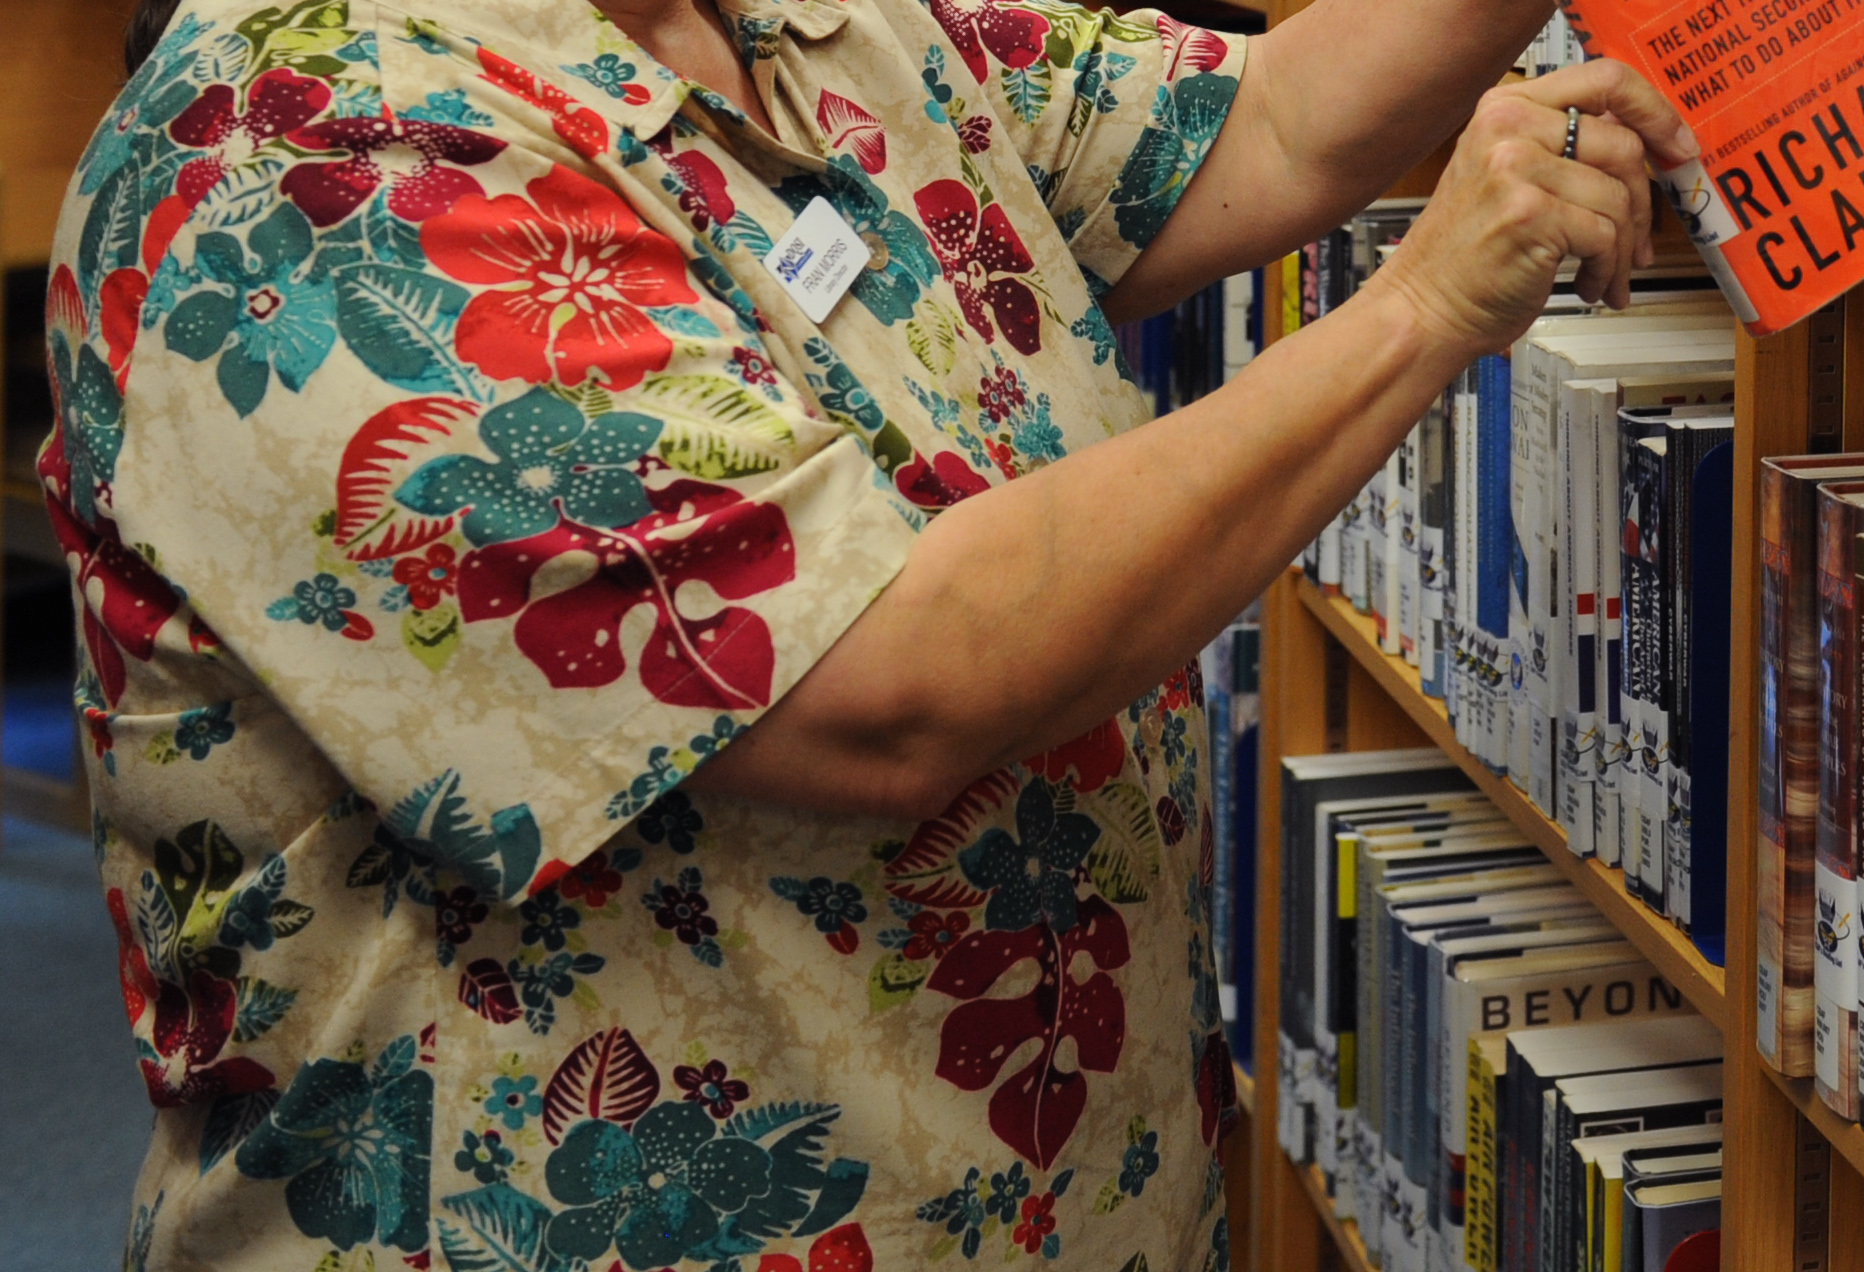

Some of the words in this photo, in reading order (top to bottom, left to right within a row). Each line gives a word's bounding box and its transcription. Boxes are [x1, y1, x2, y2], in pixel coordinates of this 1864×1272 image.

[1648, 30, 1682, 60] THE
[1664, 22, 1751, 86] NATIONAL
[1679, 70, 1728, 114] WHAT
[1732, 53, 1757, 84] TO
[1756, 36, 1784, 65] DO
[1787, 0, 1841, 47] ABOUT
[1715, 114, 1780, 160] BESTSELLING
[1781, 88, 1818, 120] AUTHOR
[1631, 563, 1640, 691] AMERICAN
[1652, 571, 1661, 697] AMERICAN
[1481, 977, 1682, 1032] BEYON
